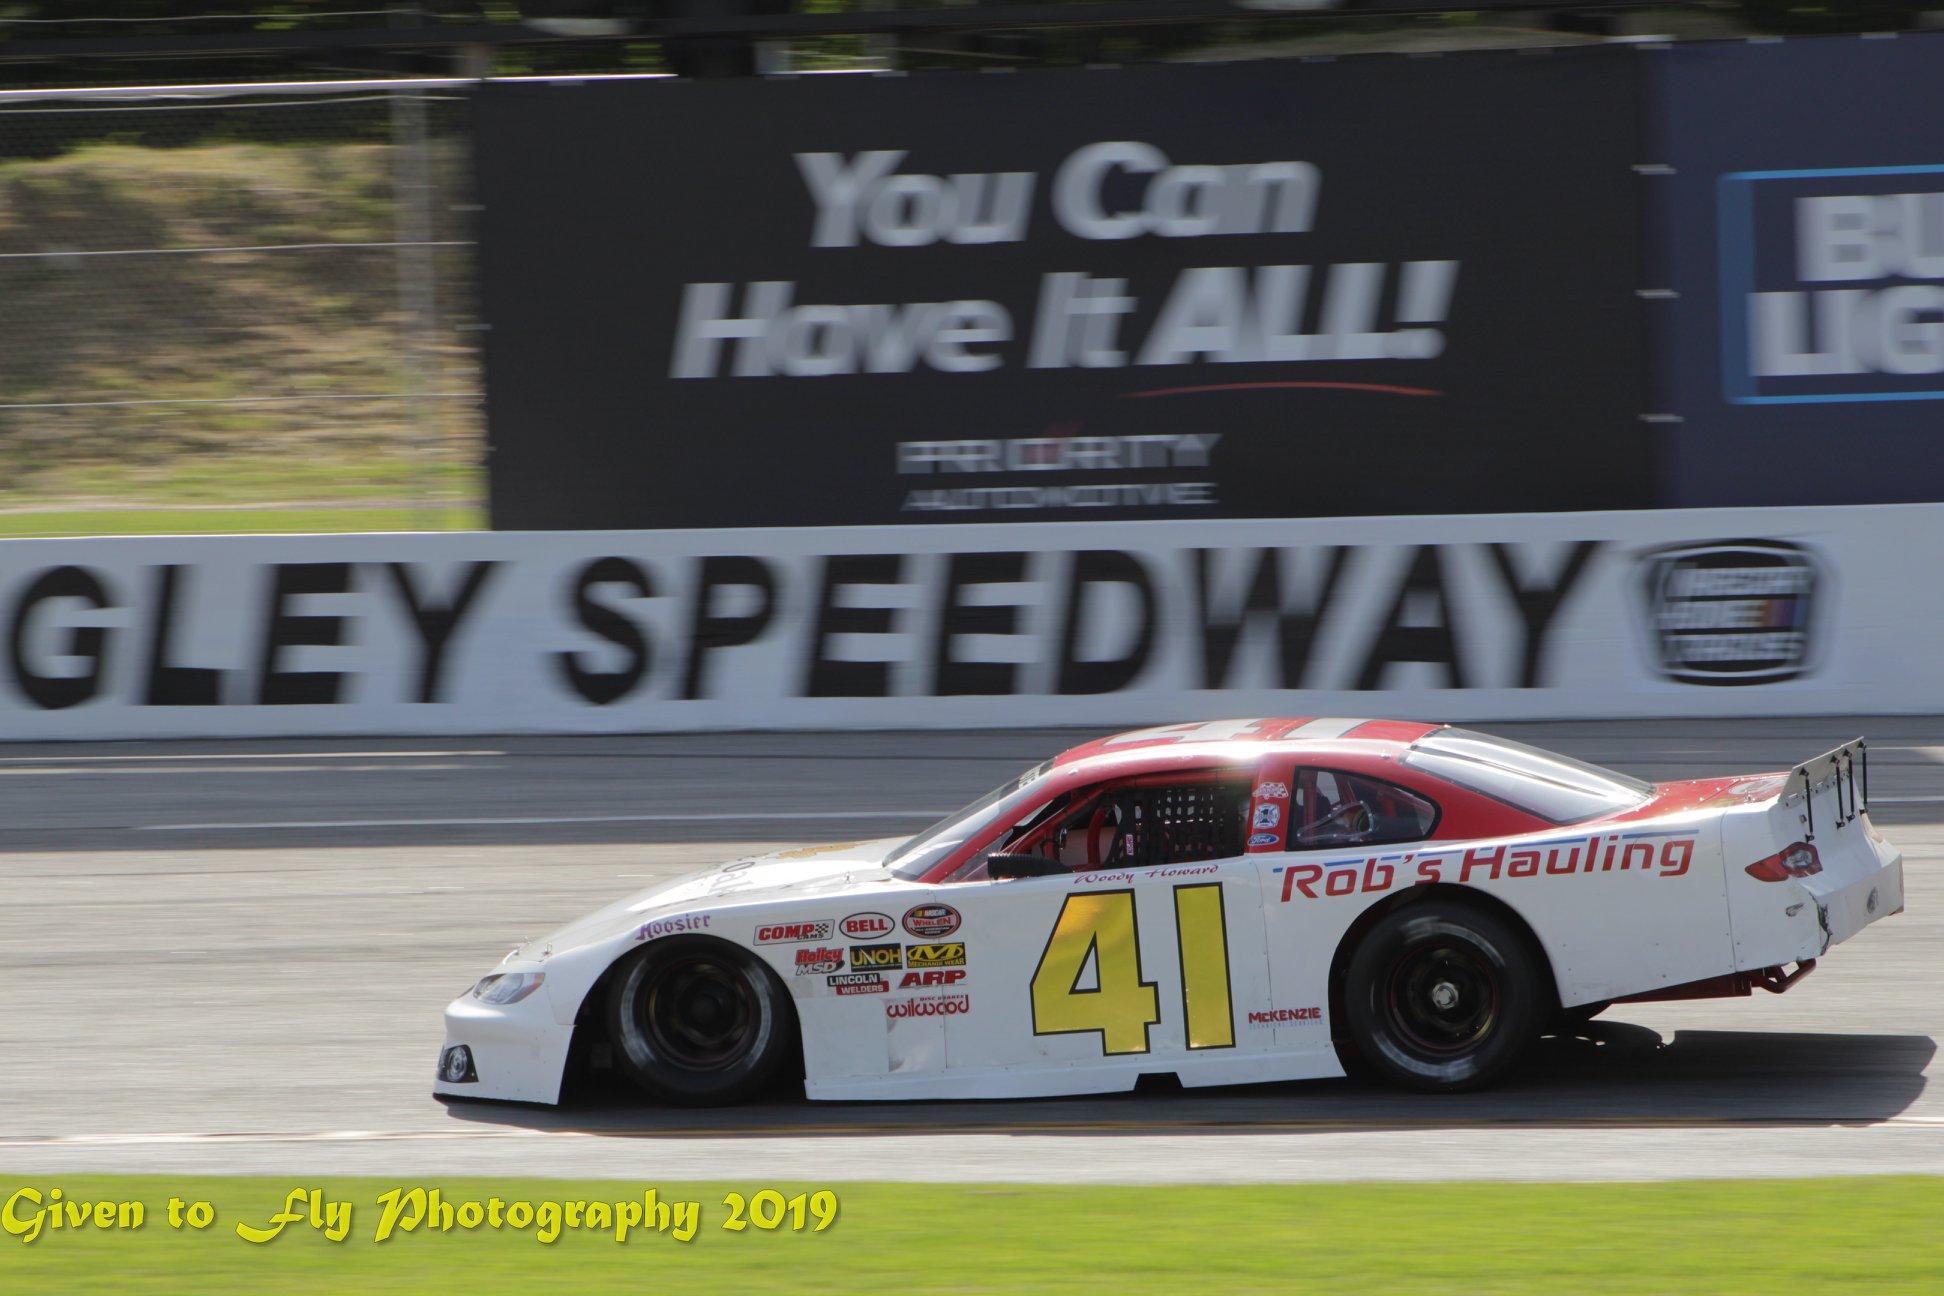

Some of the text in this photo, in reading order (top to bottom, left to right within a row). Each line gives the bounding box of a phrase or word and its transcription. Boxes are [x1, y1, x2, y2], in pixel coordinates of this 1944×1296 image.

[795, 140, 1323, 248] You Can
[668, 259, 1461, 379] Have It ALL!
[546, 538, 1610, 706] SPEEDWAY
[1074, 864, 1219, 884] Woody Howard
[1281, 834, 1696, 903] Rob's Hauling
[635, 911, 711, 940] Hoosier
[846, 919, 888, 933] BELL
[912, 917, 951, 926] WHELEN
[758, 923, 815, 941] COMP
[795, 947, 843, 965] Holley
[851, 948, 902, 966] UNOH
[796, 961, 845, 976] MSD
[1030, 882, 1236, 1057] 41
[829, 974, 878, 986] LINCOLN
[900, 970, 967, 988] ARP
[840, 985, 884, 994] WELDERS
[886, 994, 970, 1018] wilwood
